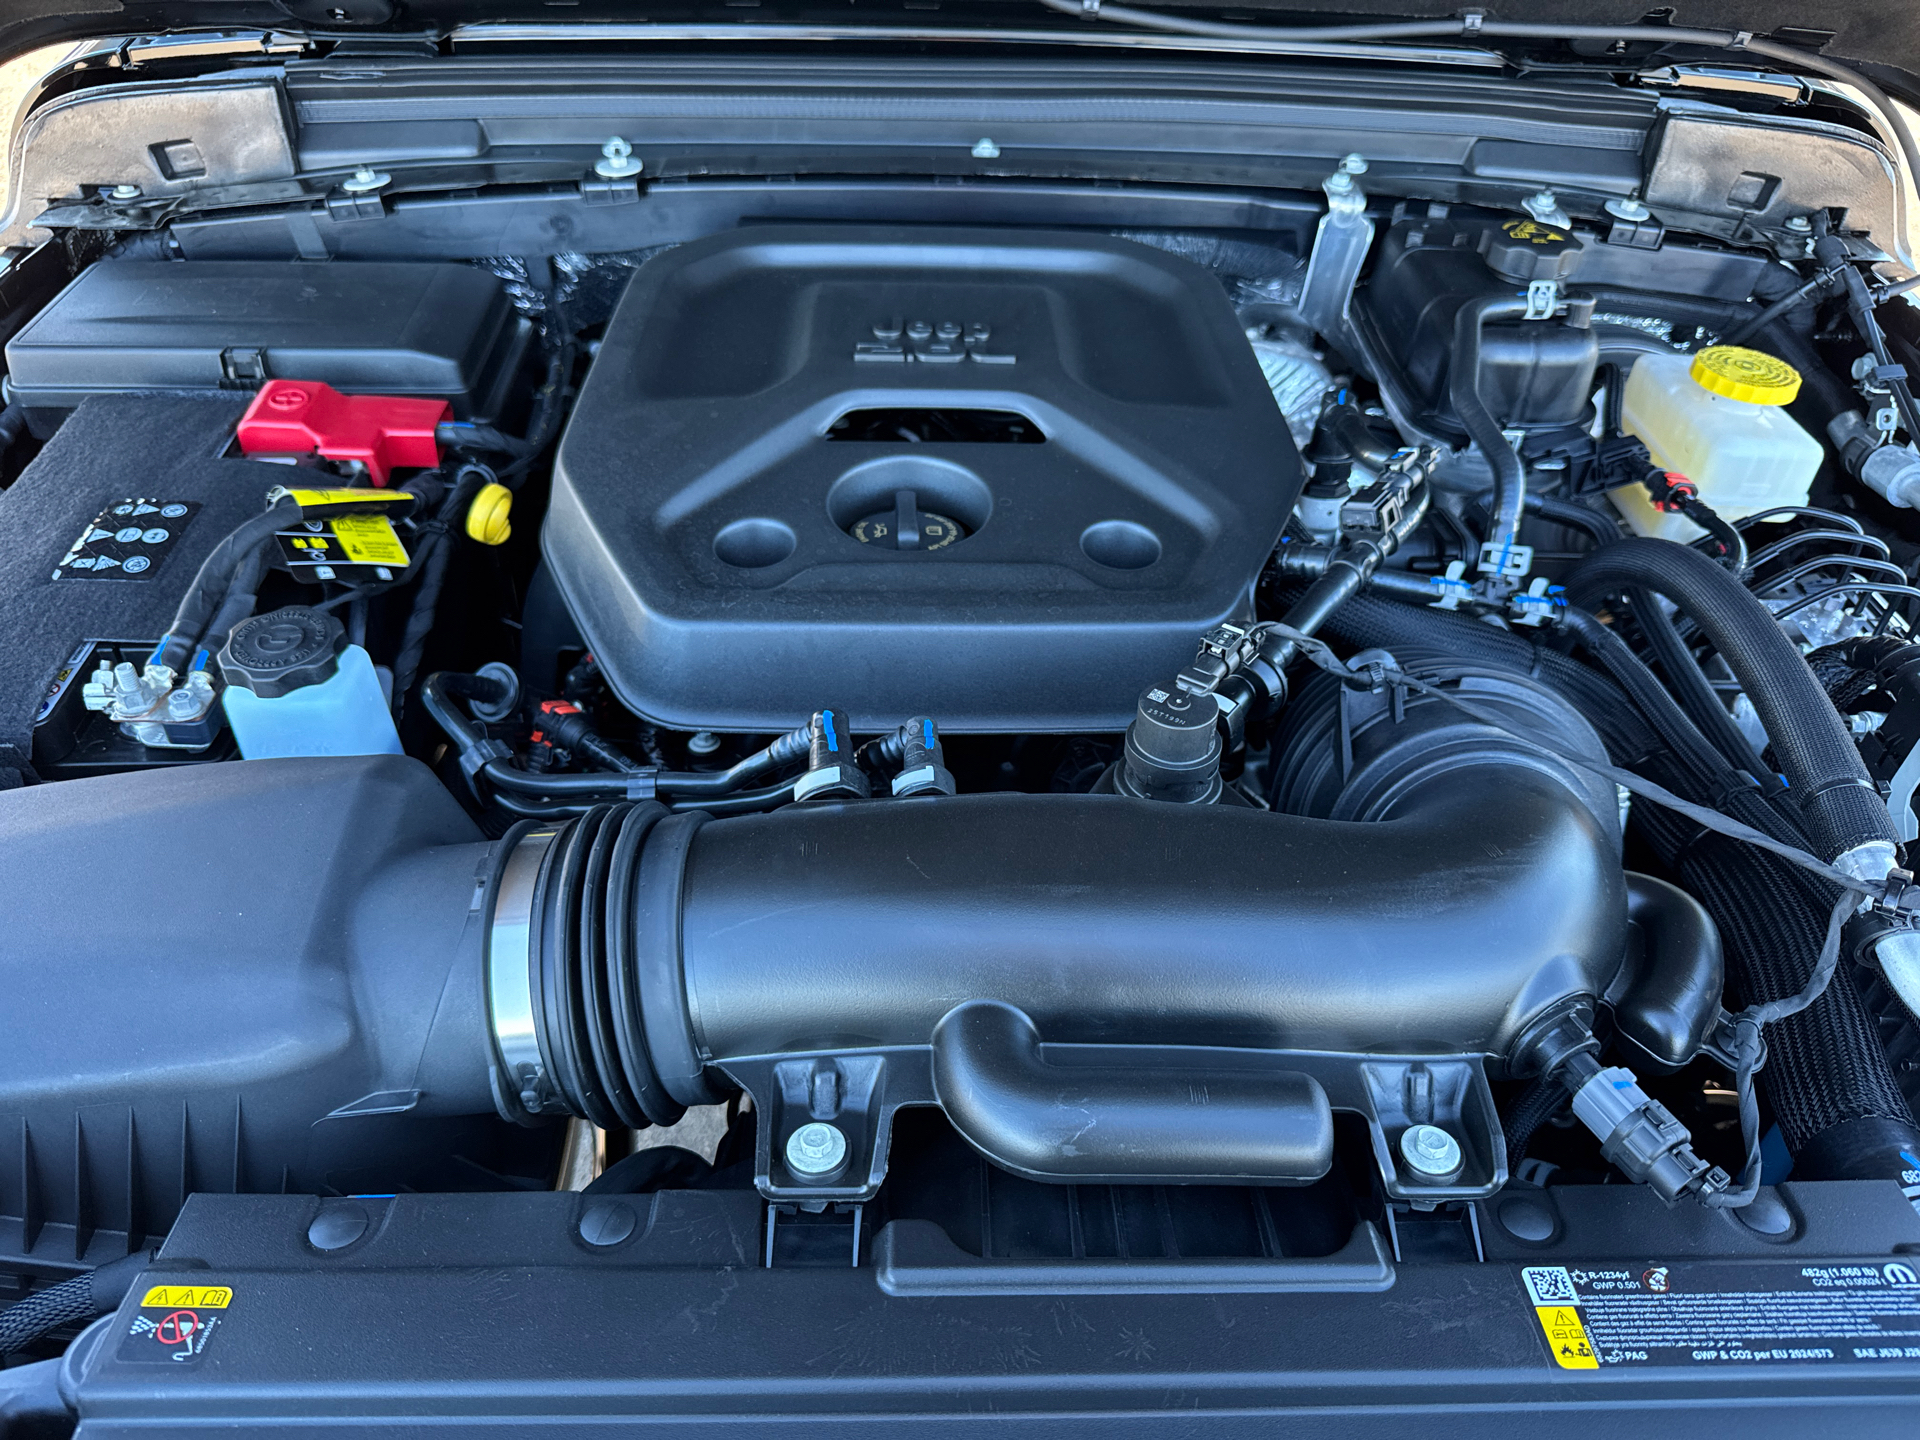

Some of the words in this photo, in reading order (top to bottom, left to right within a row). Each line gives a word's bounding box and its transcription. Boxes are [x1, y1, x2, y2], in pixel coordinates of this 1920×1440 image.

[872, 317, 991, 342] Jeep
[1588, 1270, 1630, 1280] R-1234yf
[1801, 1268, 1829, 1278] 482g
[1592, 1281, 1615, 1290] GWP
[1616, 1281, 1641, 1290] 0.501
[1812, 1278, 1834, 1286] CO2
[1625, 1350, 1648, 1361] PAG
[1692, 1350, 1717, 1361] GWP
[1719, 1350, 1729, 1360] &
[1729, 1349, 1752, 1360] CO2
[1754, 1350, 1771, 1362] per
[1771, 1349, 1788, 1360] EU
[1853, 1348, 1878, 1358] SAE
